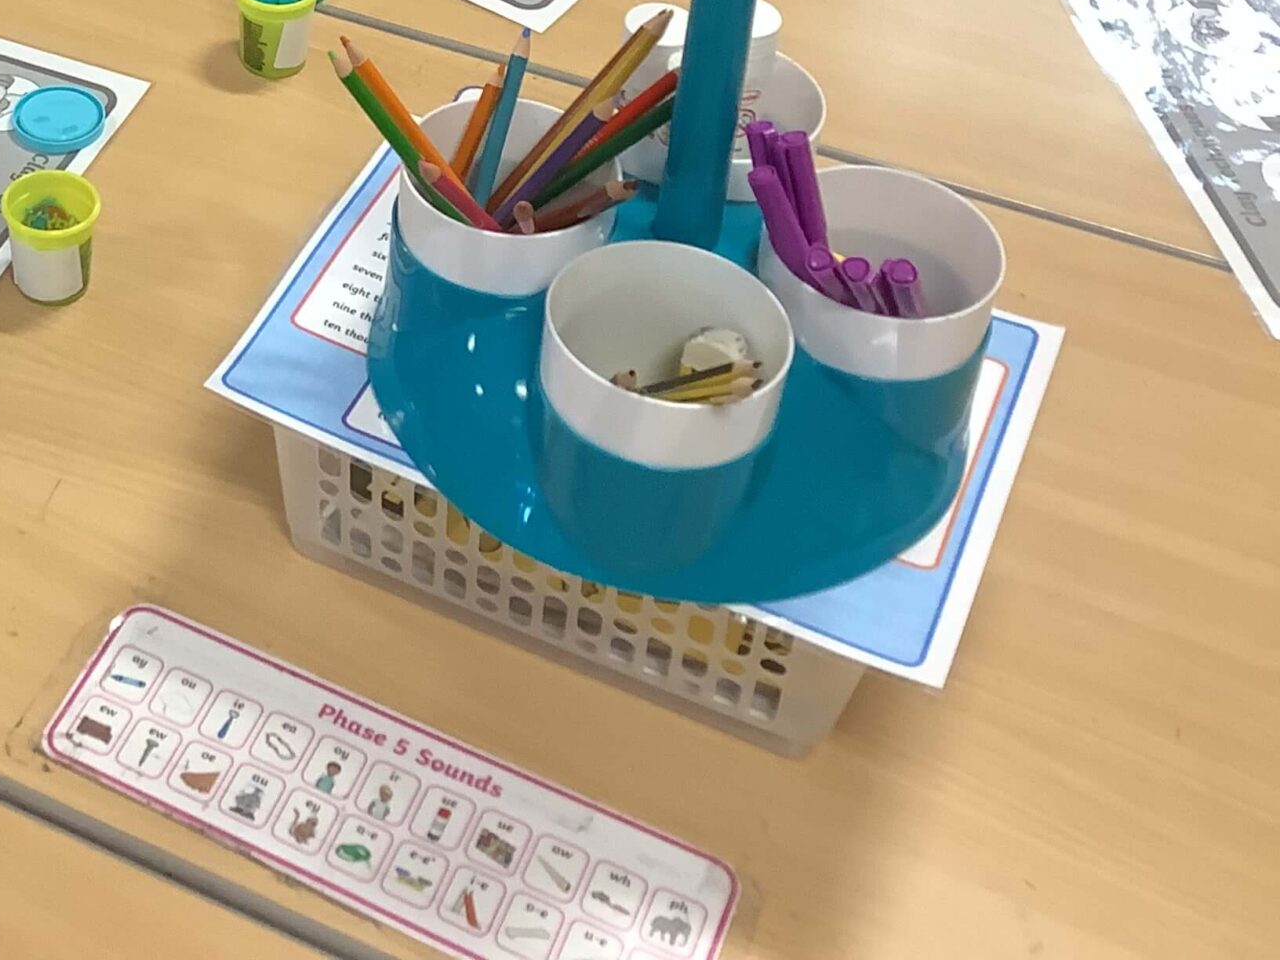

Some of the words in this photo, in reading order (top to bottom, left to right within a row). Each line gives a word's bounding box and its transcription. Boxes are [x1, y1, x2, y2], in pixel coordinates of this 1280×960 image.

[1233, 191, 1267, 227] Clay
[372, 250, 387, 261] six
[352, 264, 384, 282] seven
[342, 282, 371, 299] eight
[333, 301, 357, 316] nine
[324, 319, 342, 333] ten
[132, 654, 148, 669] ay
[181, 678, 197, 690] ou
[99, 705, 118, 717] ew
[233, 699, 245, 710] ie
[149, 727, 167, 740] ew
[282, 722, 297, 734] ea
[201, 751, 216, 762] oe
[318, 703, 388, 747] Phase
[393, 738, 410, 756] 5
[415, 748, 504, 798] Sounds
[333, 746, 350, 761] oy
[252, 774, 269, 787] au
[389, 771, 401, 783] ir
[305, 799, 321, 814] ey
[441, 796, 458, 808] ue
[497, 820, 514, 833] ue
[552, 845, 574, 859] aw
[609, 871, 631, 888] wh
[669, 900, 688, 914] ph
